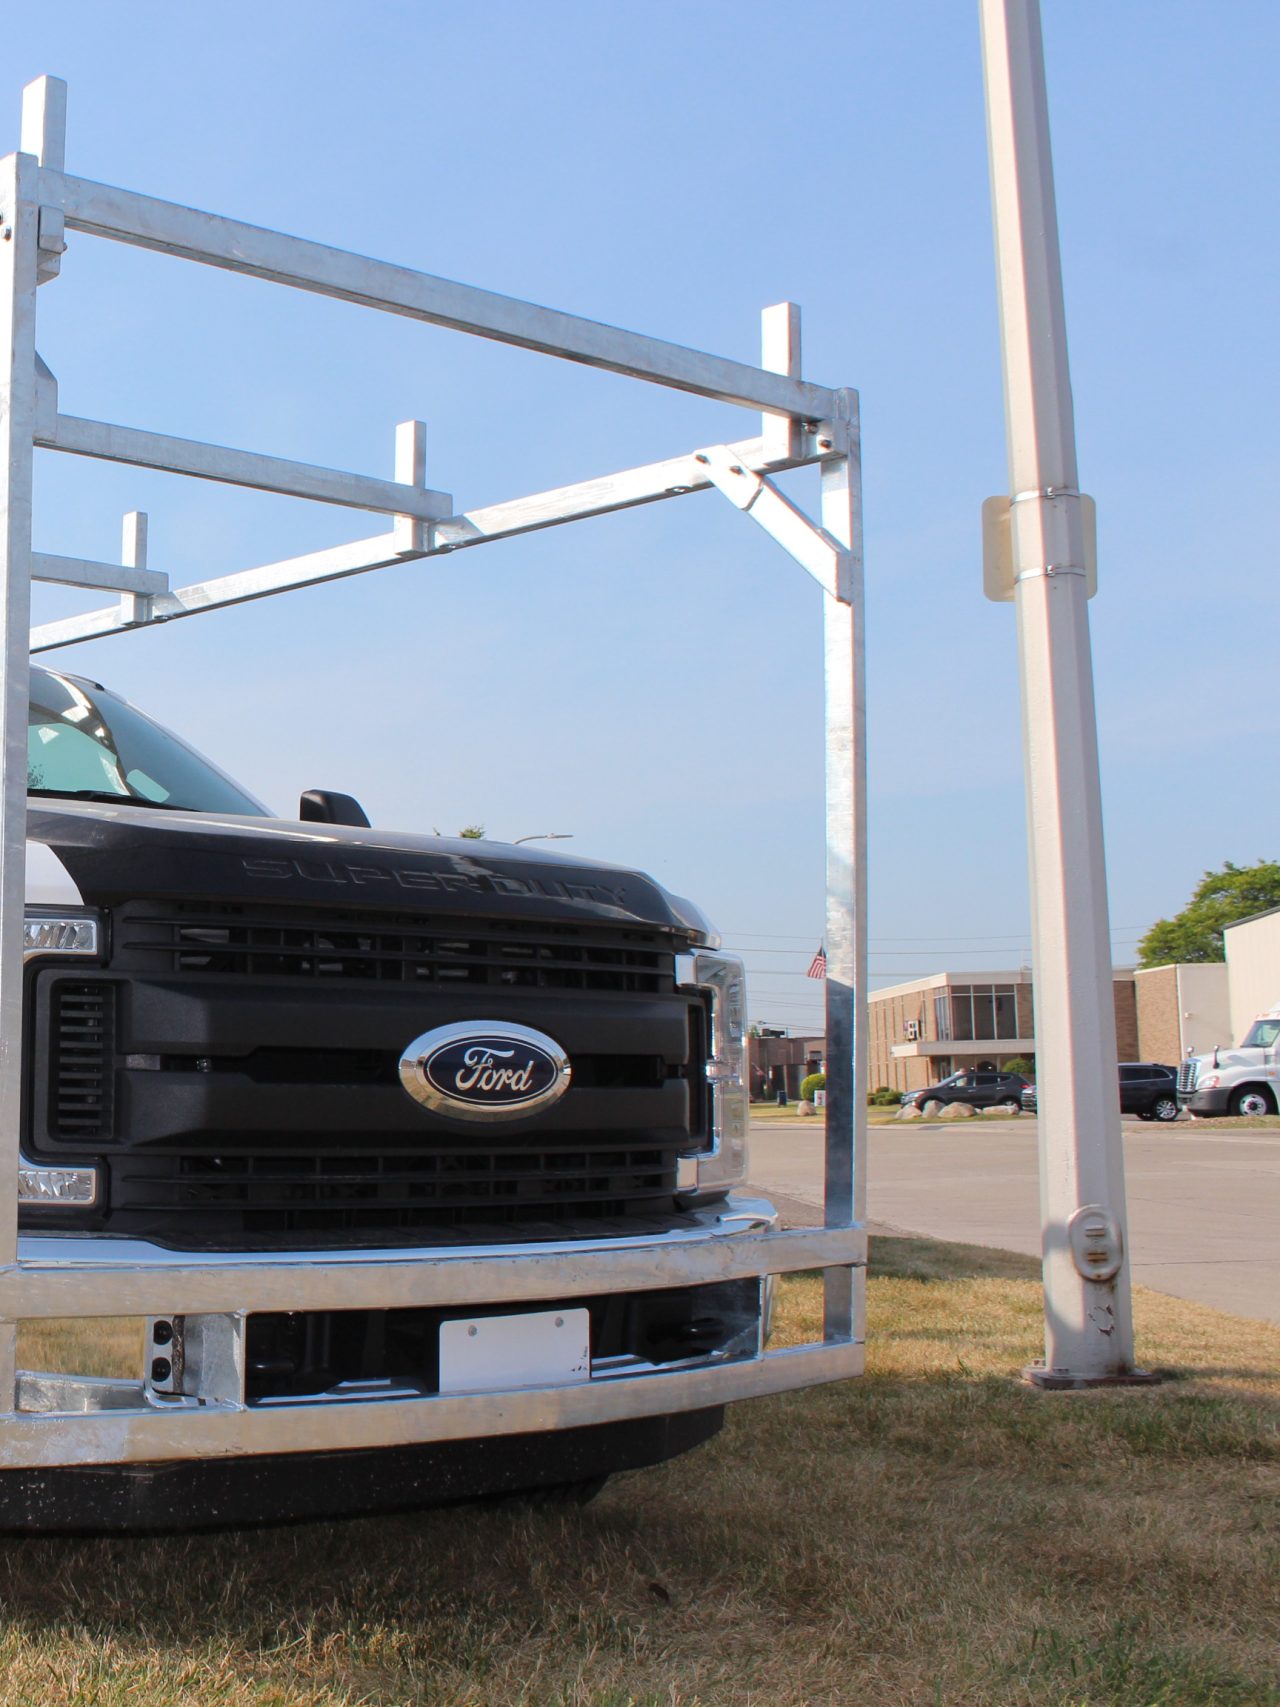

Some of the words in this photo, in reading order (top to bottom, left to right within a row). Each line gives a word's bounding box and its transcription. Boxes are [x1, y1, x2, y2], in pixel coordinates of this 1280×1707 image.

[241, 859, 483, 893] SUPER
[486, 875, 625, 905] DUTY
[455, 1046, 535, 1092] Ford
